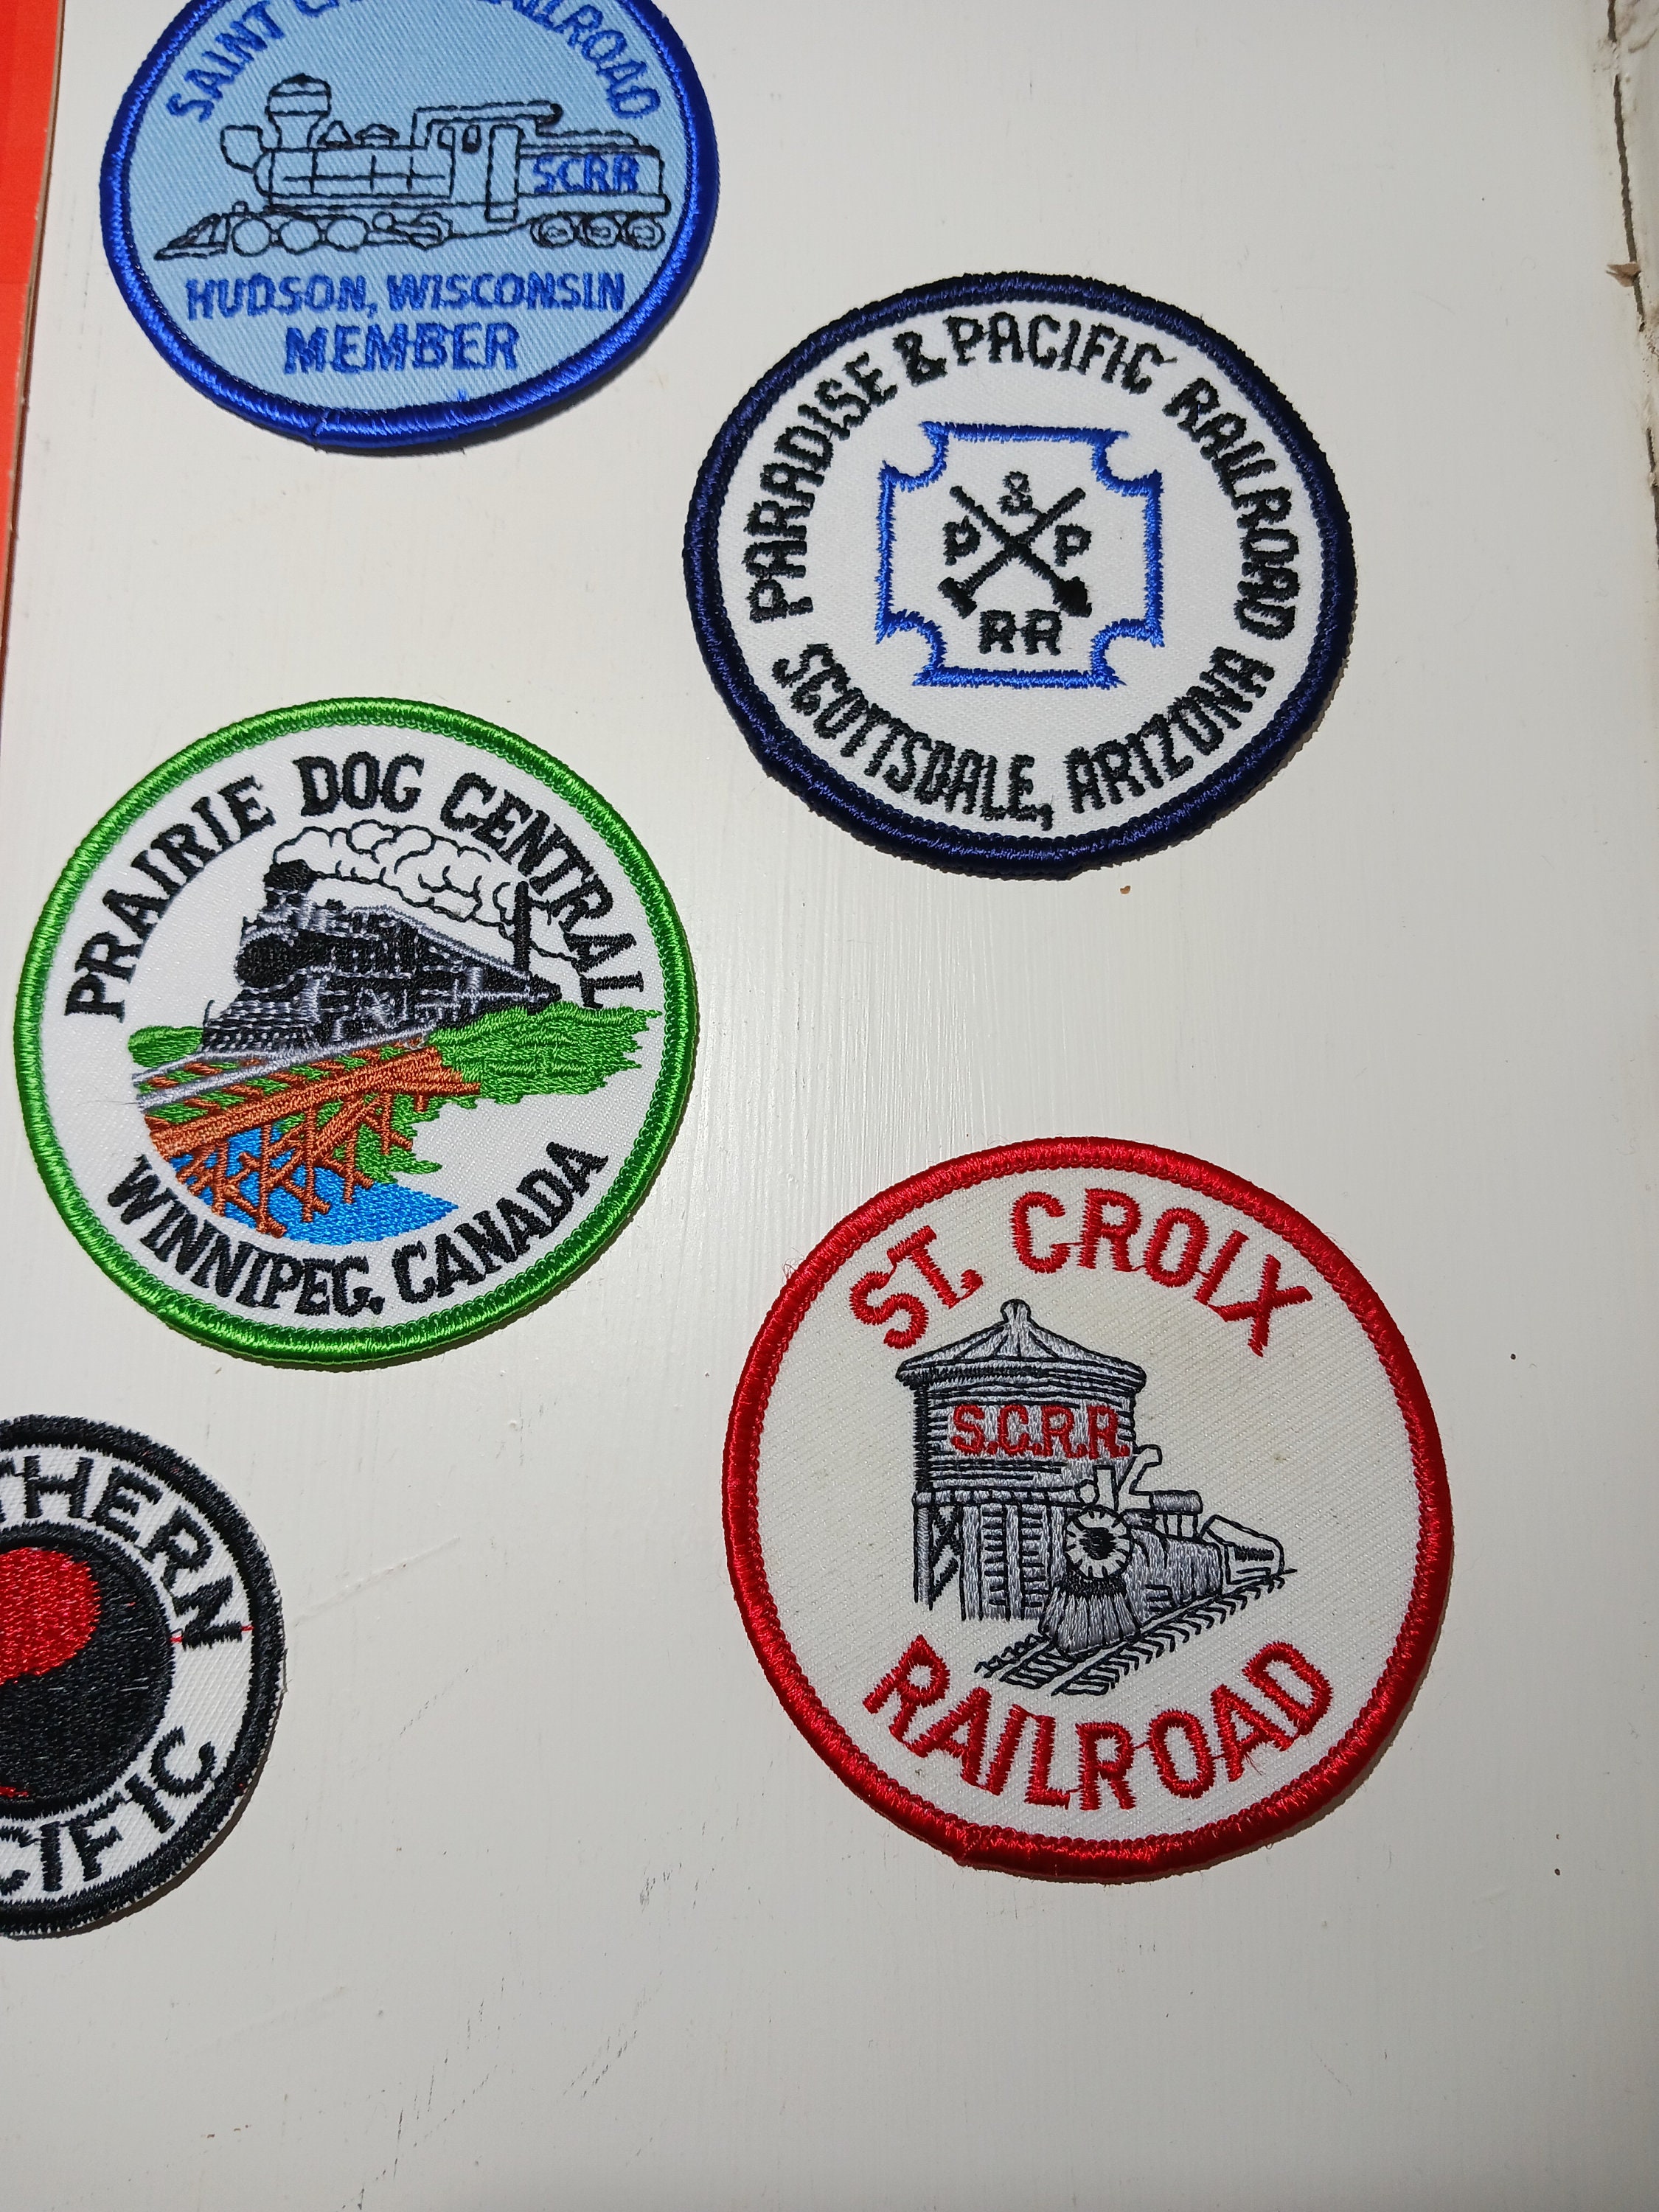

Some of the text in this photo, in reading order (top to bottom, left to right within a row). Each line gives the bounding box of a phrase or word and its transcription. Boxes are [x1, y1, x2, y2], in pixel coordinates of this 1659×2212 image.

[166, 0, 661, 122] SAINT LROAD
[533, 152, 639, 194] SCRR
[186, 271, 626, 320] HUDSON, WISCONSIN
[285, 321, 519, 375] MEMBER
[742, 312, 1301, 641] PARADISE & PACIFIC RAILROAD
[1054, 523, 1092, 567] P
[772, 643, 1276, 831] SCOTTSDALE, ARIZONA
[64, 751, 644, 1023] PRAIRIE DOG CENTRAL
[392, 1142, 609, 1304] CANADA
[1010, 1189, 1312, 1357] CROIX
[950, 1403, 1131, 1460] S.C.R.R.
[863, 1635, 1332, 1810] RAILROAD
